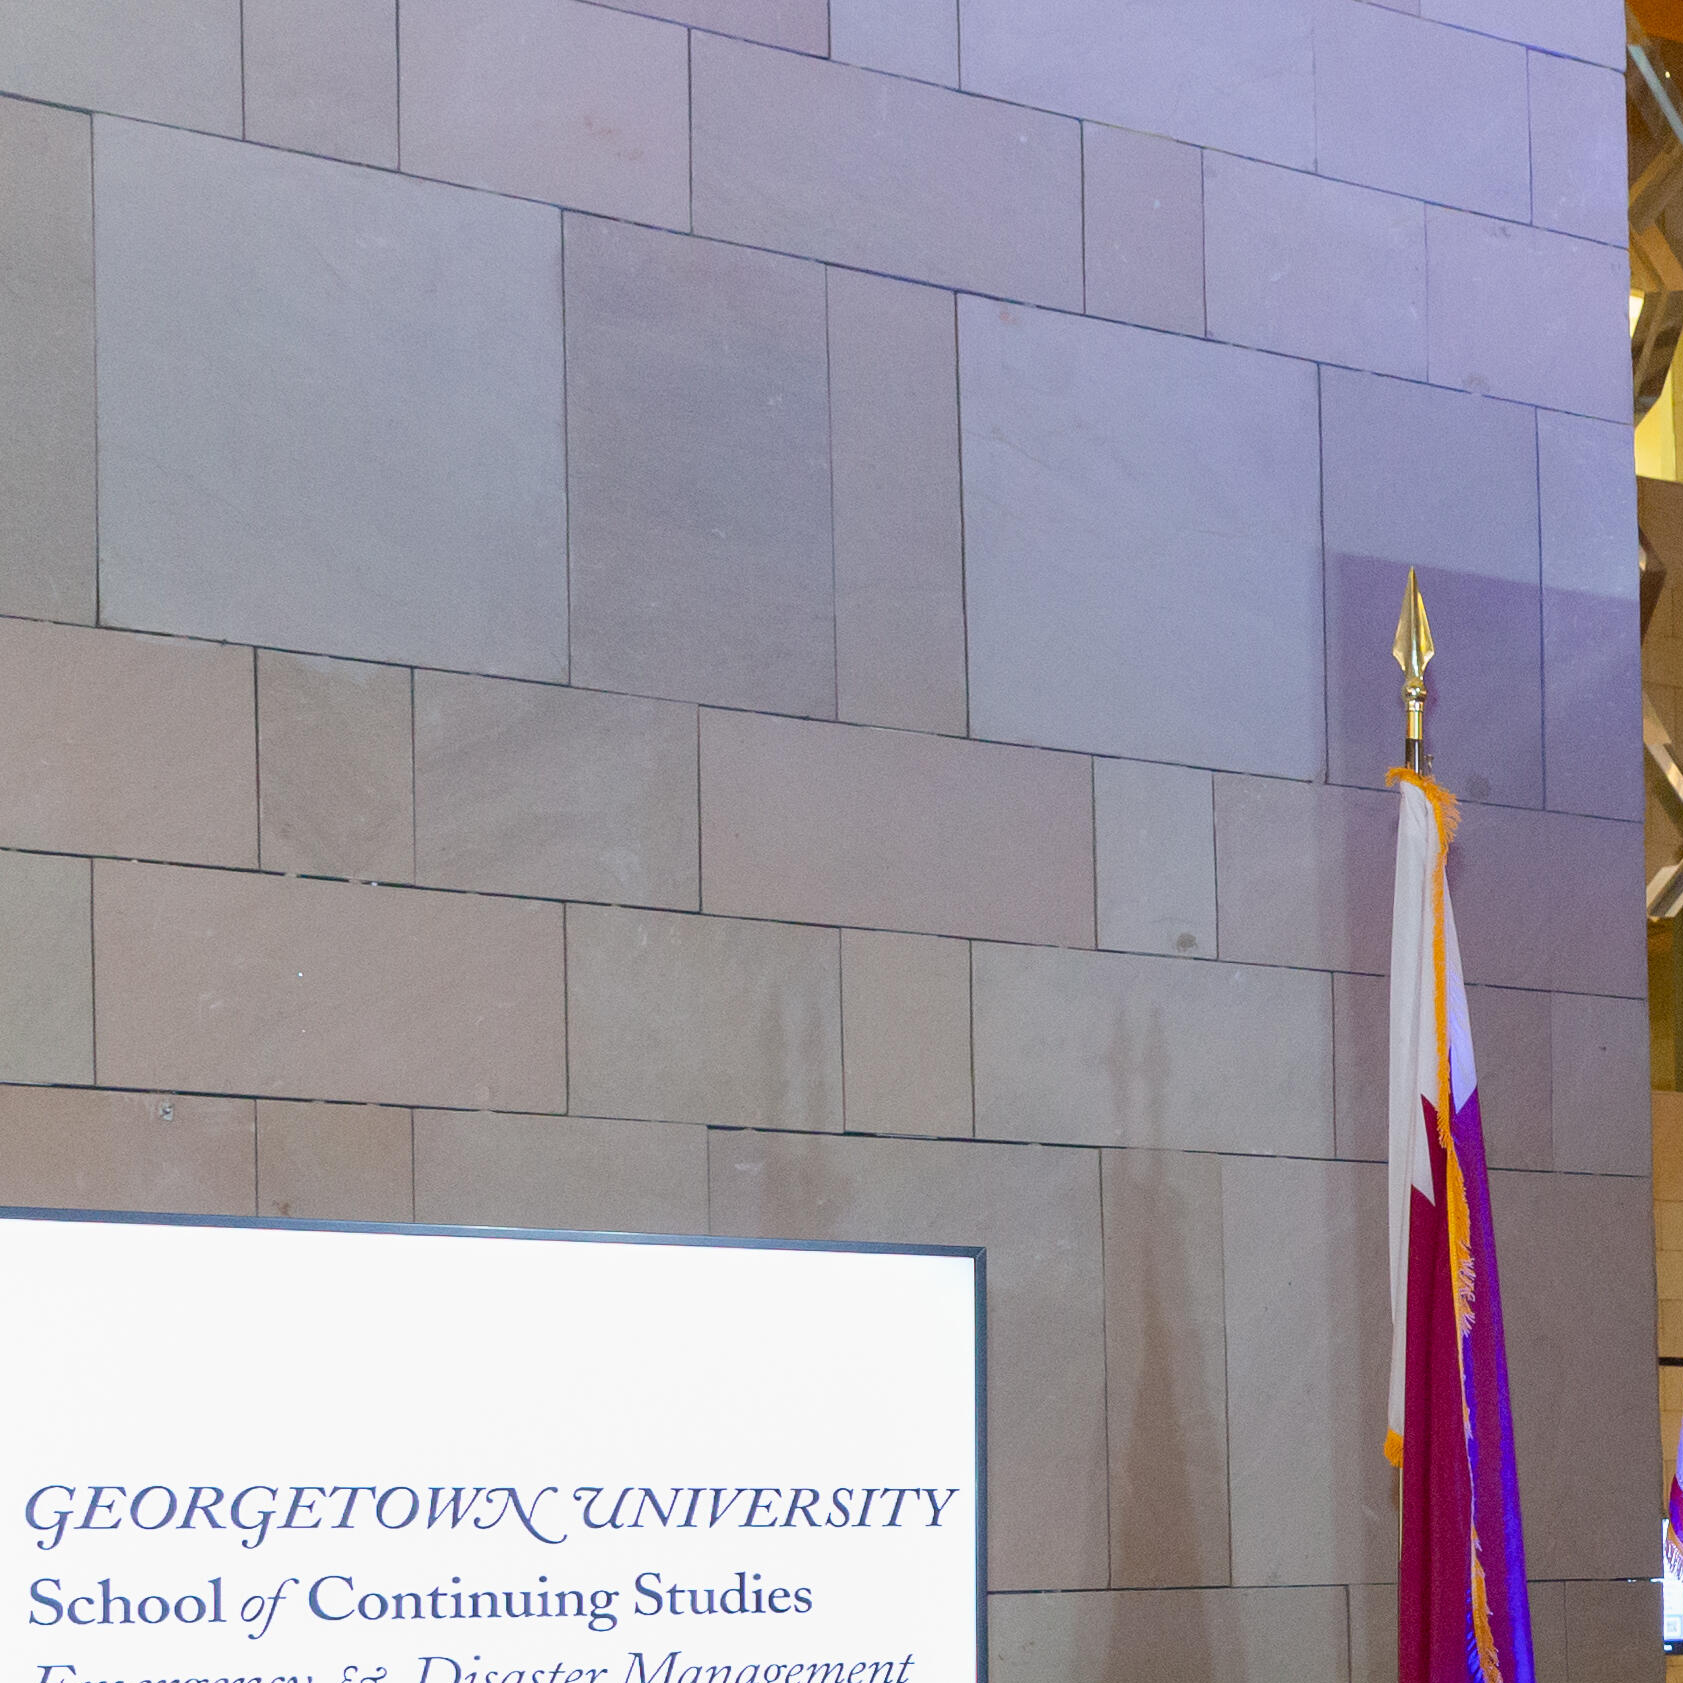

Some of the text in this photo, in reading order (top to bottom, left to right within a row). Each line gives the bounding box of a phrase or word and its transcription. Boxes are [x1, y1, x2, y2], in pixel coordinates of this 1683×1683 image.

[26, 1485, 960, 1550] GEORGETOWN UNIVERSITY
[29, 1571, 812, 1640] School of Continuing Studies
